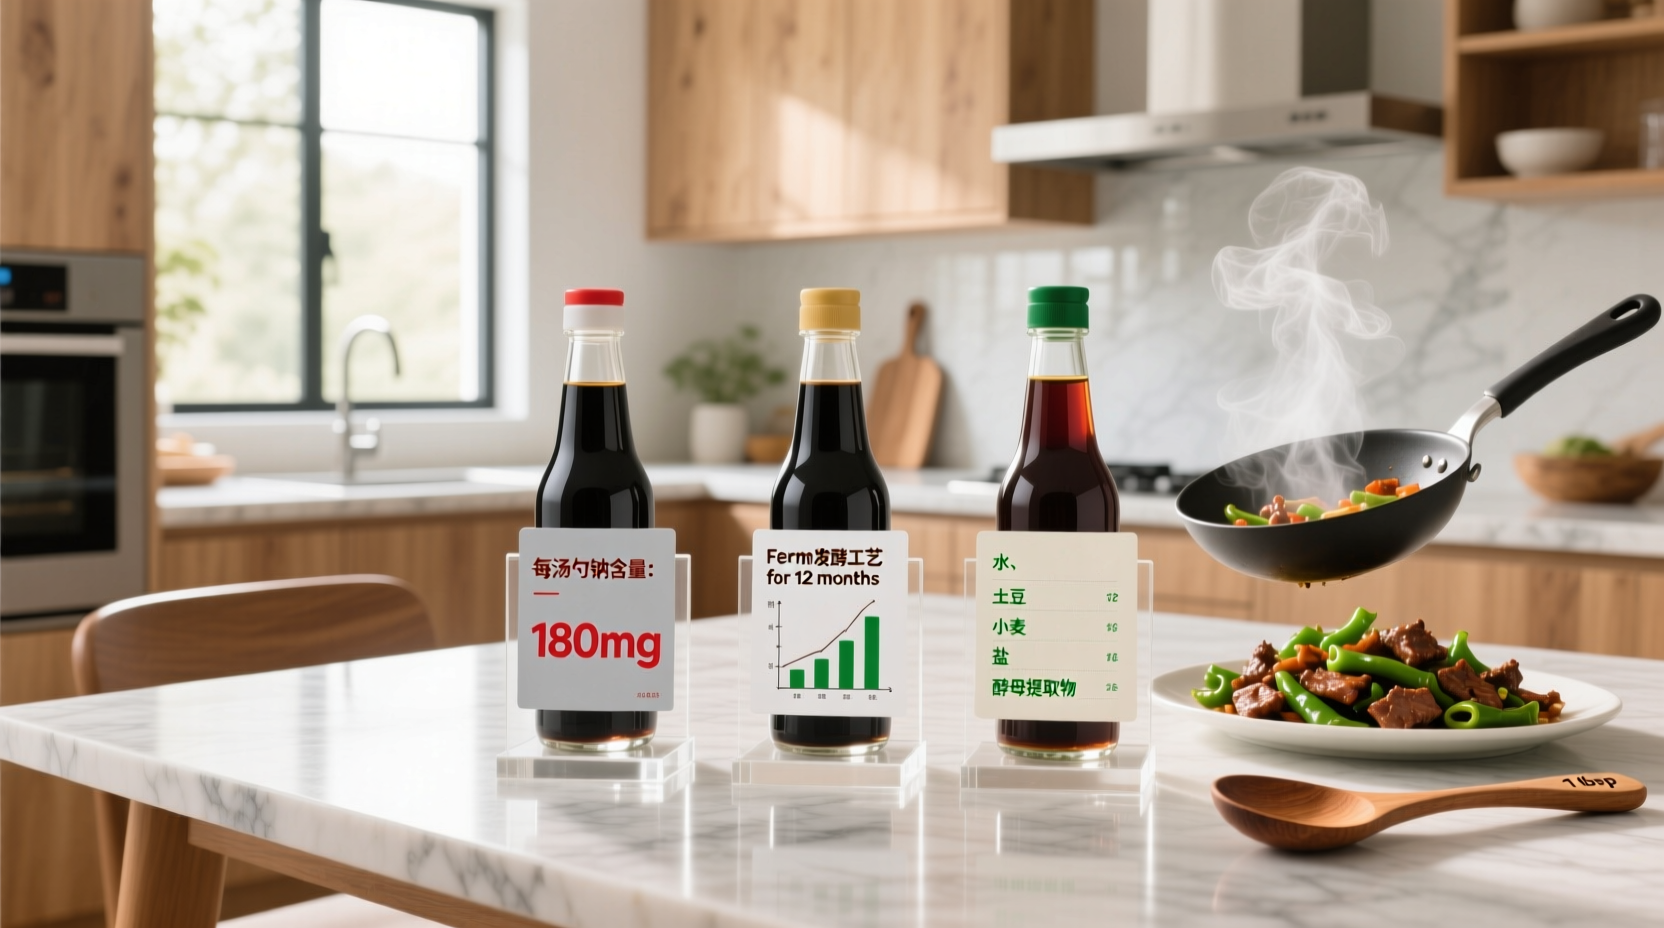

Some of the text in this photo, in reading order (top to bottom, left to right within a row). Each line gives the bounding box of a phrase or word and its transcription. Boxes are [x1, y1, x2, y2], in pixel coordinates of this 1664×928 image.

[766, 569, 880, 586] for 12 months
[992, 587, 1026, 605] 土豆
[992, 617, 1026, 636] 小麦
[531, 621, 662, 669] 180mg
[991, 646, 1009, 665] 盐
[992, 677, 1077, 697] 酵母提取物
